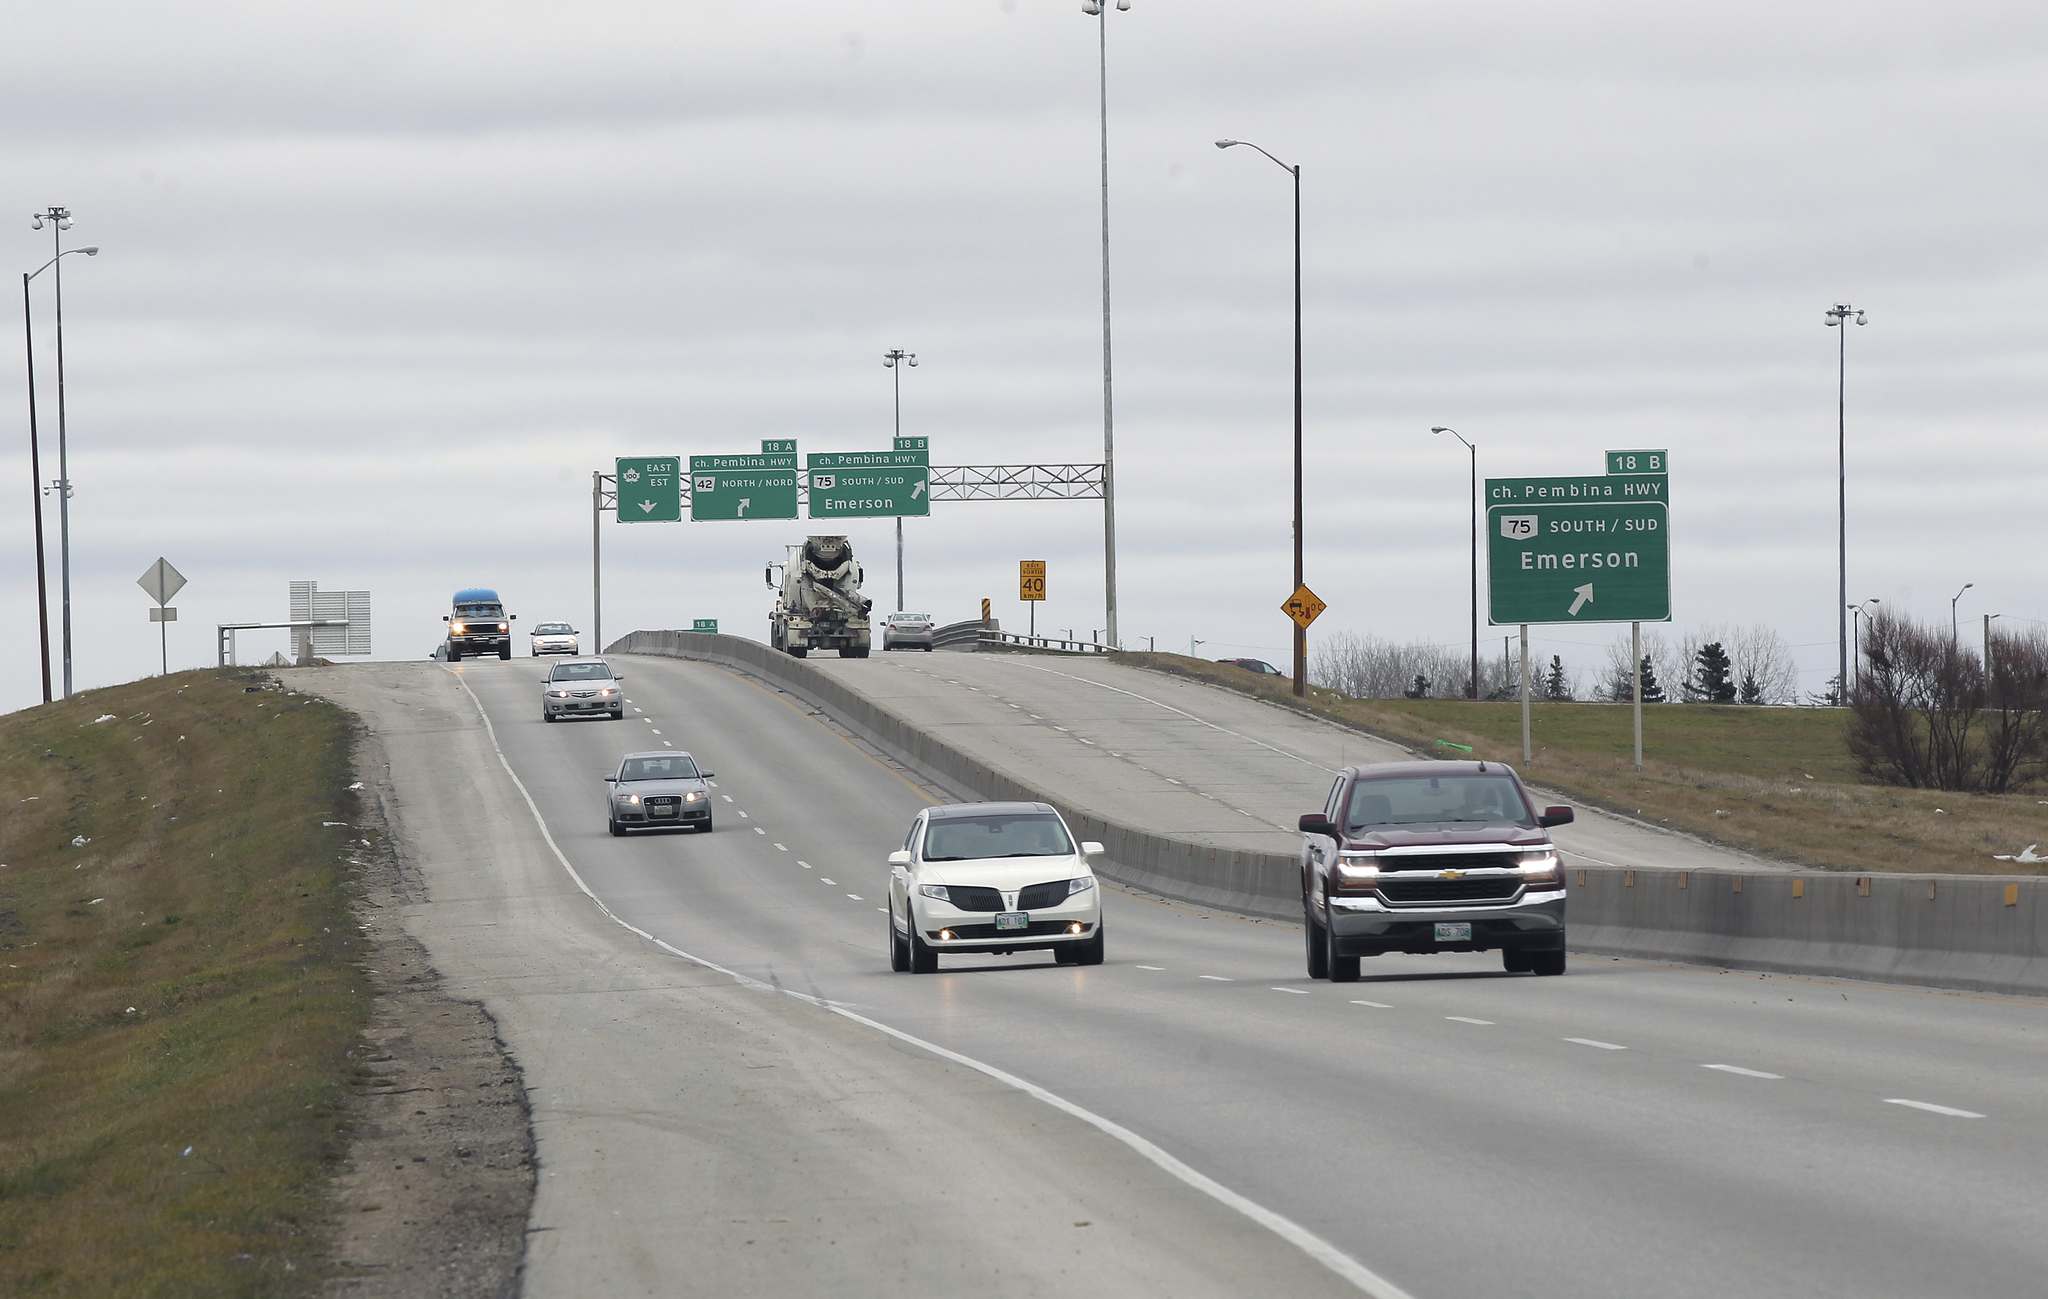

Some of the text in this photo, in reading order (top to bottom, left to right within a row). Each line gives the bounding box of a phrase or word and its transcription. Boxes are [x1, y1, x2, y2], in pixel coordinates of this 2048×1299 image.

[767, 442, 793, 451] 18 A
[899, 440, 925, 448] 18 B
[695, 457, 792, 468] ch. Pembina HWY
[819, 454, 917, 465] ch. Pembina HWY
[1616, 456, 1661, 470] 18 B
[647, 464, 671, 472] EAST
[697, 480, 713, 489] 42
[722, 480, 755, 488] NORTH
[766, 479, 793, 487] NORD
[817, 477, 832, 486] 75
[842, 478, 874, 486] SOUTH
[885, 477, 904, 485] SUD
[1492, 483, 1661, 498] ch. Pembina HWY
[825, 499, 893, 510] Emerson
[1508, 520, 1531, 534] 75
[1550, 520, 1606, 532] SOUTH
[1625, 519, 1658, 531] SUD
[1521, 551, 1639, 570] Emerson
[1023, 578, 1043, 592] 40
